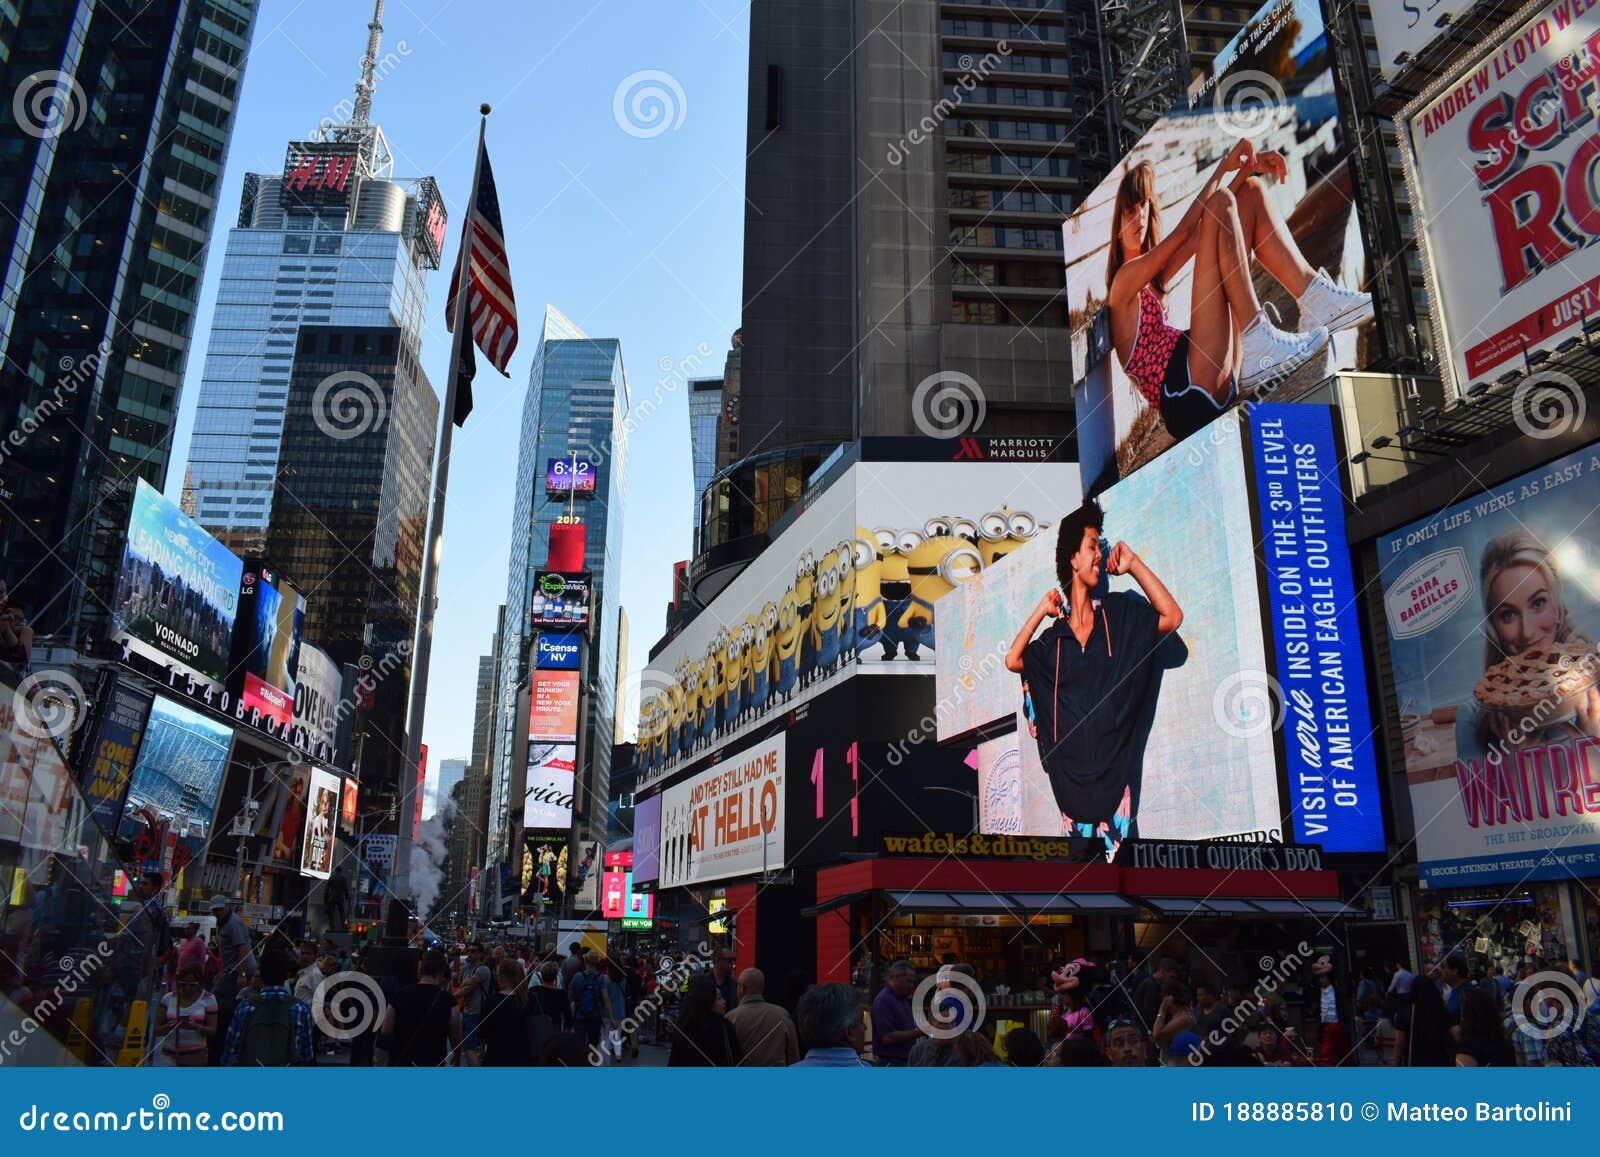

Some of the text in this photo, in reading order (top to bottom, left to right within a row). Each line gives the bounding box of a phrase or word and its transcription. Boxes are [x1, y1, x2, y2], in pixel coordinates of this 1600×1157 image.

[1239, 39, 1249, 55] ON
[1249, 16, 1271, 43] THESE
[1493, 18, 1551, 81] LLOYD
[1551, 287, 1593, 327] JUST
[989, 439, 1054, 447] MARRIOTT
[990, 449, 1047, 458] MARQUIS
[554, 461, 589, 476] 6:42
[1391, 538, 1403, 553] IF
[1406, 522, 1440, 547] ONLY
[1443, 510, 1473, 532] LIFE
[1474, 491, 1517, 519] WERE
[1520, 480, 1541, 501] AS
[1543, 462, 1584, 491] EASY
[241, 586, 254, 595] LG
[1399, 579, 1459, 623] BAREILLES
[1410, 576, 1440, 601] SARA
[155, 621, 199, 657] VORNADO
[1260, 418, 1329, 836] VISIT aerie INSIDE ON THE 3RD LEVEL
[1293, 443, 1359, 807] OF AMERICAN EAGLE OUTFITTERS
[540, 643, 578, 653] ICsense
[550, 653, 566, 662] NV
[293, 681, 319, 726] OVE
[236, 698, 338, 765] BROADWAY
[98, 739, 135, 766] COME
[87, 777, 124, 801] AWAY
[689, 784, 704, 805] AND
[704, 773, 723, 797] THEY
[723, 769, 743, 793] STILL
[743, 756, 762, 783] HAD
[763, 750, 778, 775] ME
[690, 804, 709, 852] AT
[1483, 821, 1596, 846] THE HIT BROADWAY
[1133, 843, 1323, 872] MIGHTY QUINN'S BBQ
[1431, 865, 1459, 877] BROOKS
[1459, 862, 1499, 874] ATKINSON
